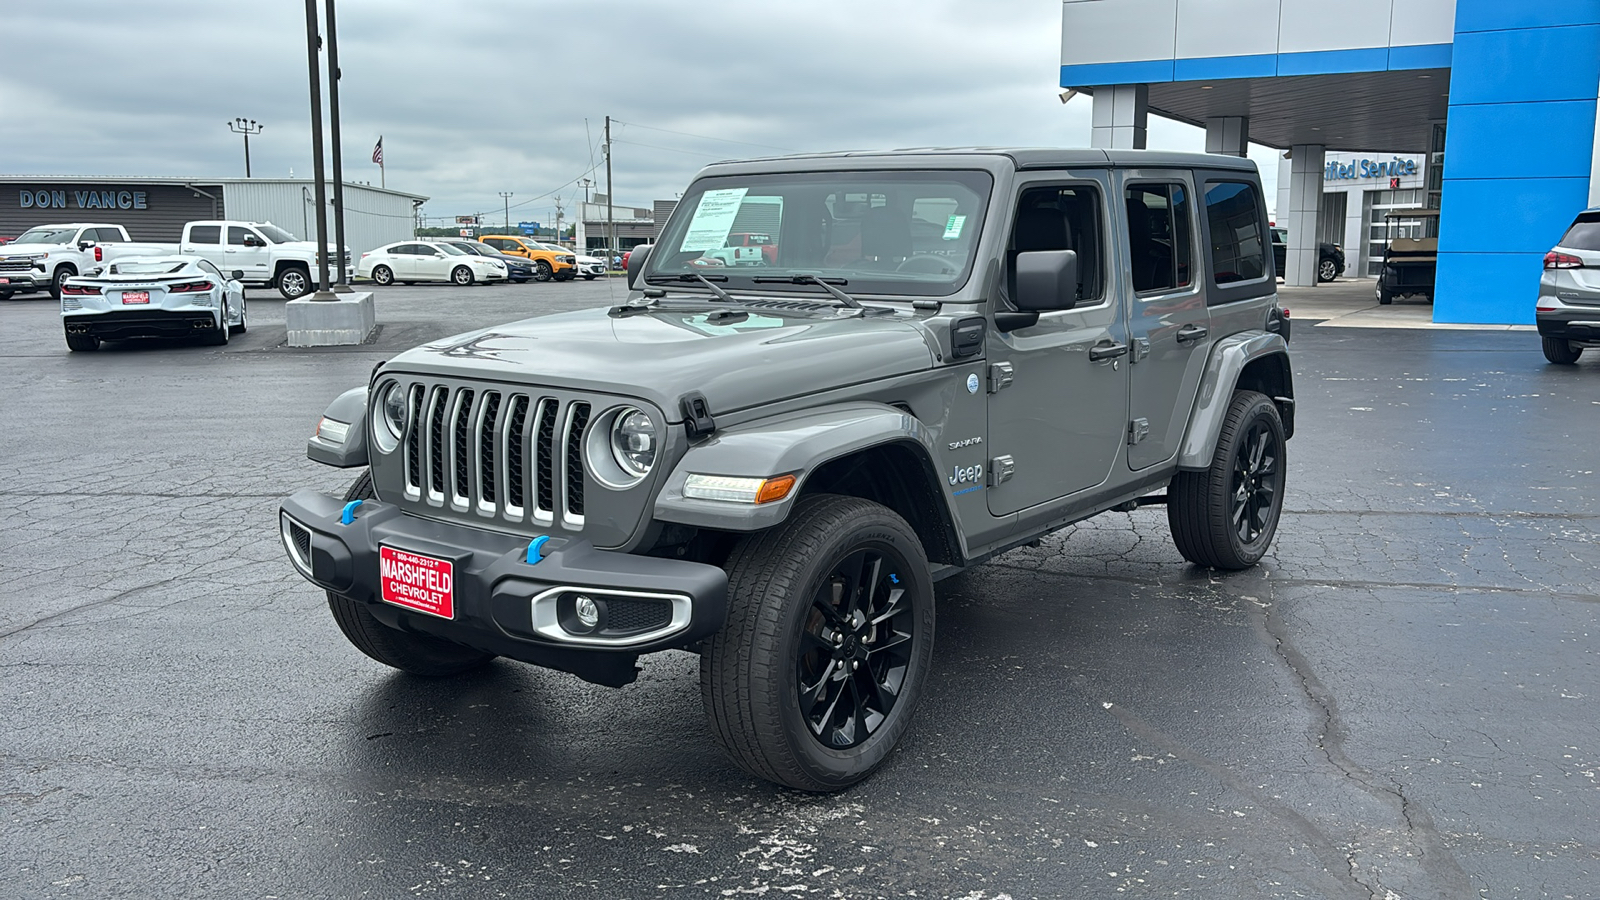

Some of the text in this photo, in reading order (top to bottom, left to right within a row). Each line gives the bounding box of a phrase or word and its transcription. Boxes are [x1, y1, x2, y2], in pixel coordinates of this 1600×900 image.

[1325, 156, 1415, 181] ified Service
[19, 190, 147, 209] DON VANCE
[948, 436, 983, 450] SAHARA
[948, 464, 983, 486] Jeep
[397, 553, 434, 567] 800-440-2312
[382, 557, 451, 593] MARSHFIELD
[390, 581, 444, 606] CHEVROLET
